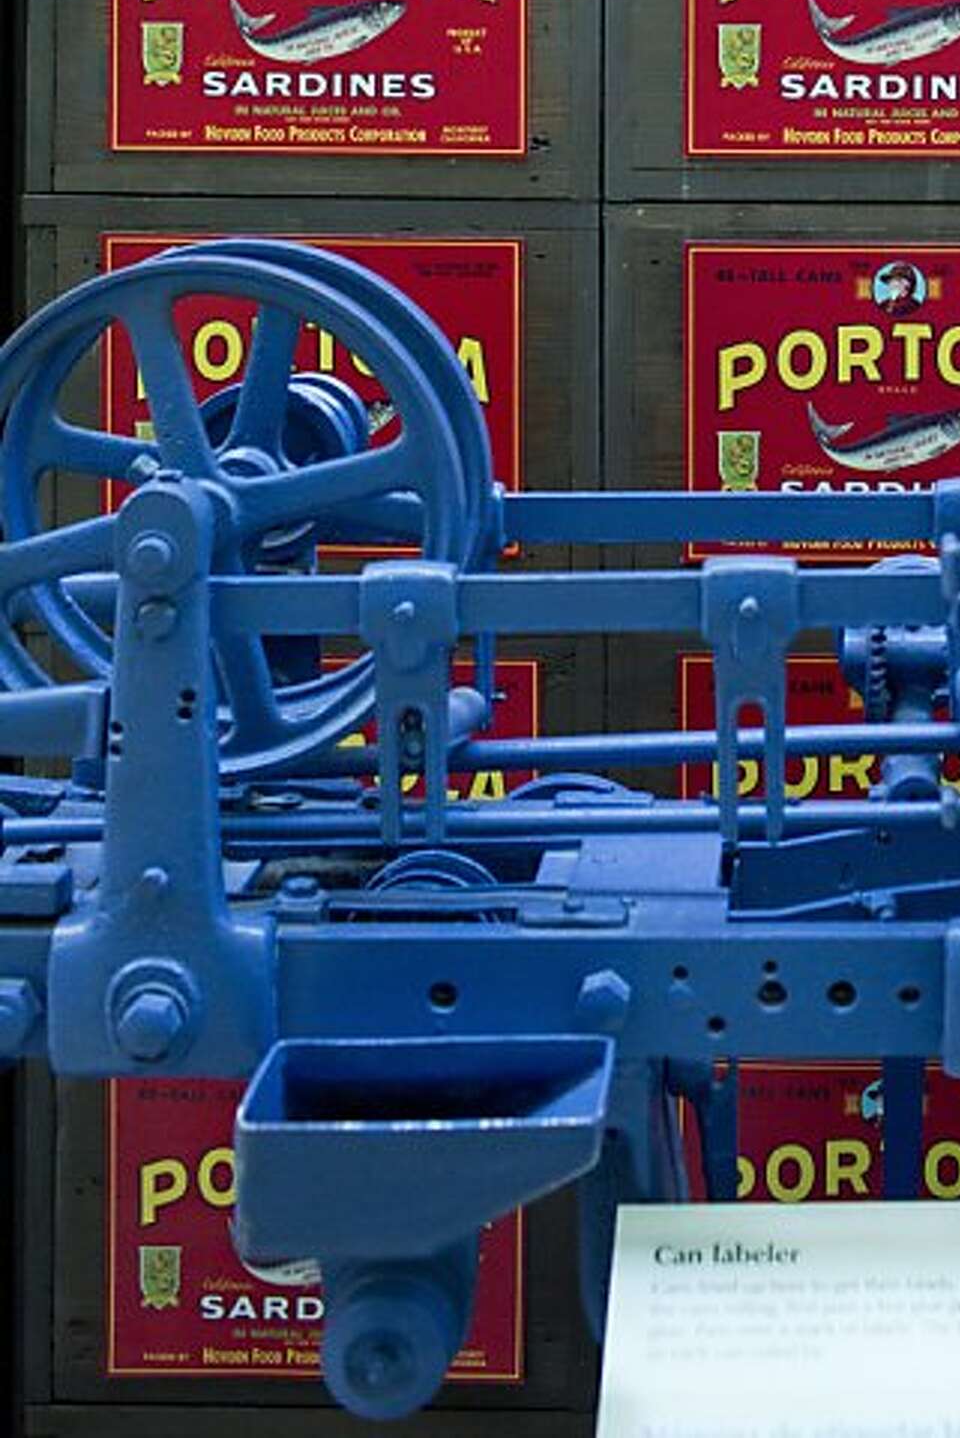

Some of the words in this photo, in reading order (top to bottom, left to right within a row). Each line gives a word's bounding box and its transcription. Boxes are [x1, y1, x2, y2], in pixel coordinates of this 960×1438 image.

[202, 71, 436, 98] SARDINES
[254, 125, 286, 141] FOOD
[289, 125, 346, 141] PRODUCTS
[349, 126, 427, 142] CORPORATION
[833, 128, 865, 144] FOOD
[868, 128, 926, 144] PRODUCTS
[654, 1245, 702, 1264] Can
[713, 1243, 799, 1263] labeler
[200, 1295, 325, 1320] SARD
